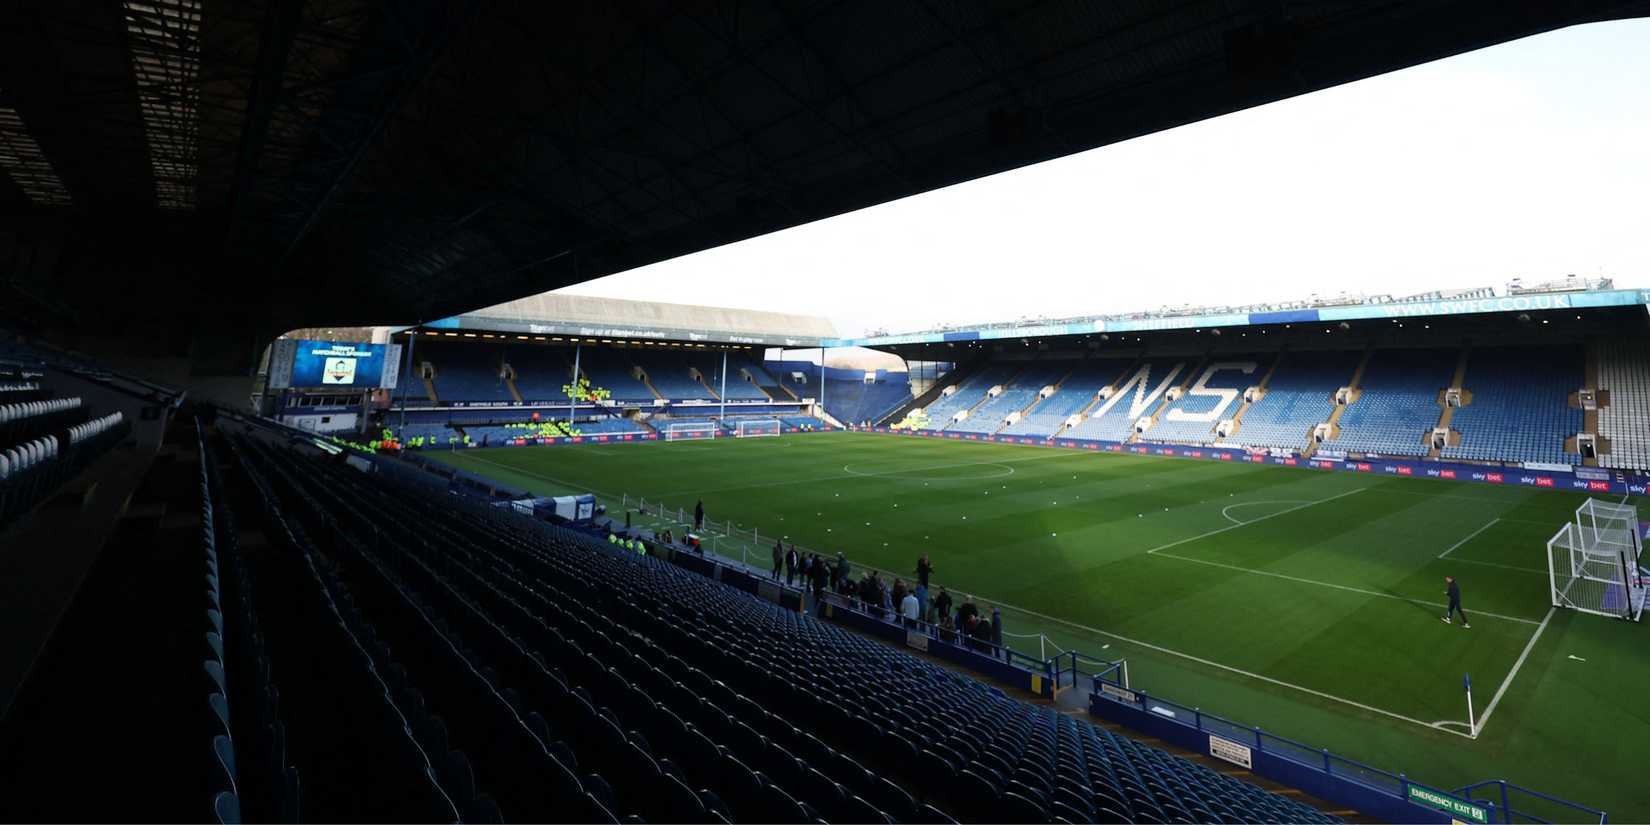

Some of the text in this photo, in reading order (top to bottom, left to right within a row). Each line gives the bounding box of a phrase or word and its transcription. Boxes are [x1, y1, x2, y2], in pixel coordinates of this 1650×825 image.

[1385, 295, 1568, 316] WWW.SWFC.CO.UK
[1346, 463, 1356, 471] sky
[1385, 466, 1411, 474] sky bet
[1427, 469, 1454, 478] sky bet
[1472, 473, 1502, 482] sky bet
[1521, 477, 1552, 486] sky bet
[1573, 480, 1608, 490] sky bet
[1630, 485, 1647, 494] sky
[1411, 788, 1471, 815] EMERGENCY EXIT
